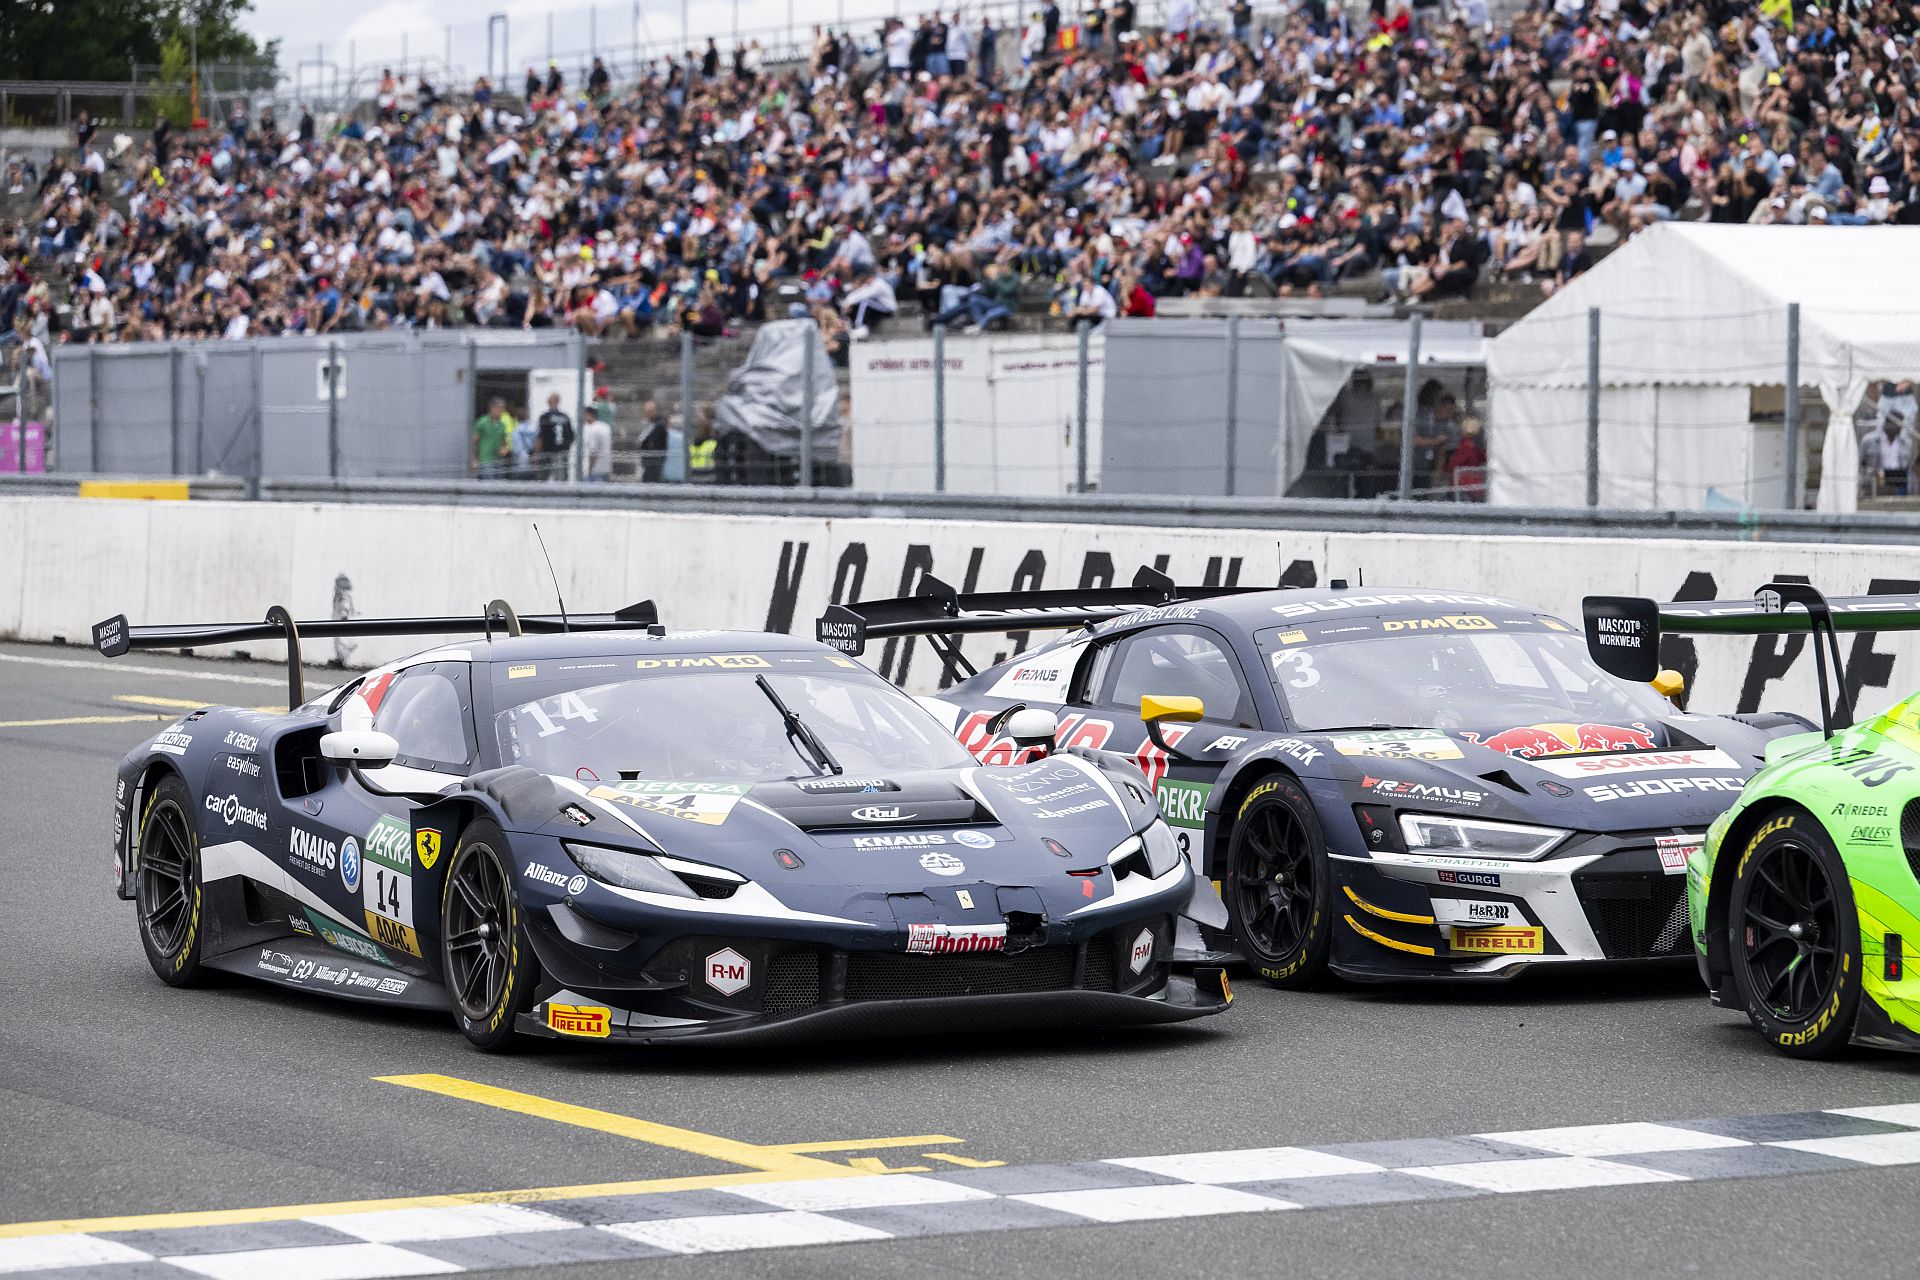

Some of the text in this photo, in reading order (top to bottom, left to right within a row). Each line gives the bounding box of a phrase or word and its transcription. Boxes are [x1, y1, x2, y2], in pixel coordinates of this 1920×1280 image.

[1114, 613, 1141, 629] VAN
[1141, 608, 1166, 623] DER
[1165, 606, 1200, 620] LINDE
[1382, 618, 1450, 632] DTM
[1598, 633, 1641, 648] WORKWEAR
[636, 656, 758, 669] DTM 40
[1285, 651, 1320, 688] 3
[1013, 668, 1058, 682] REMUS
[521, 690, 600, 738] 14
[233, 734, 260, 752] REICH
[226, 755, 262, 778] easydriver
[1575, 755, 1707, 772] SONAX
[616, 782, 743, 794] DEKRA
[798, 778, 885, 790] FREEBIRD
[1375, 779, 1482, 802] REMUS
[1582, 777, 1746, 802] SÜDPAC
[864, 806, 900, 819] Paul
[1851, 805, 1889, 817] RIEDEL
[853, 834, 947, 848] KNAUS
[1850, 825, 1894, 840] ENDLESS
[289, 826, 336, 870] KNAUS
[1737, 816, 1796, 880] PIRELLI
[1426, 857, 1511, 868] SCHAEFFLER
[523, 861, 568, 889] Allianz
[1458, 873, 1500, 886] GURGL
[376, 869, 400, 918] 14
[1469, 903, 1494, 917] H&R
[375, 916, 411, 954] ADAC
[1456, 930, 1536, 949] PIRELLI
[260, 948, 273, 961] MF
[313, 965, 339, 982] Allianz
[552, 1009, 603, 1033] PIRELLI
[1779, 1008, 1832, 1046] ZERO
